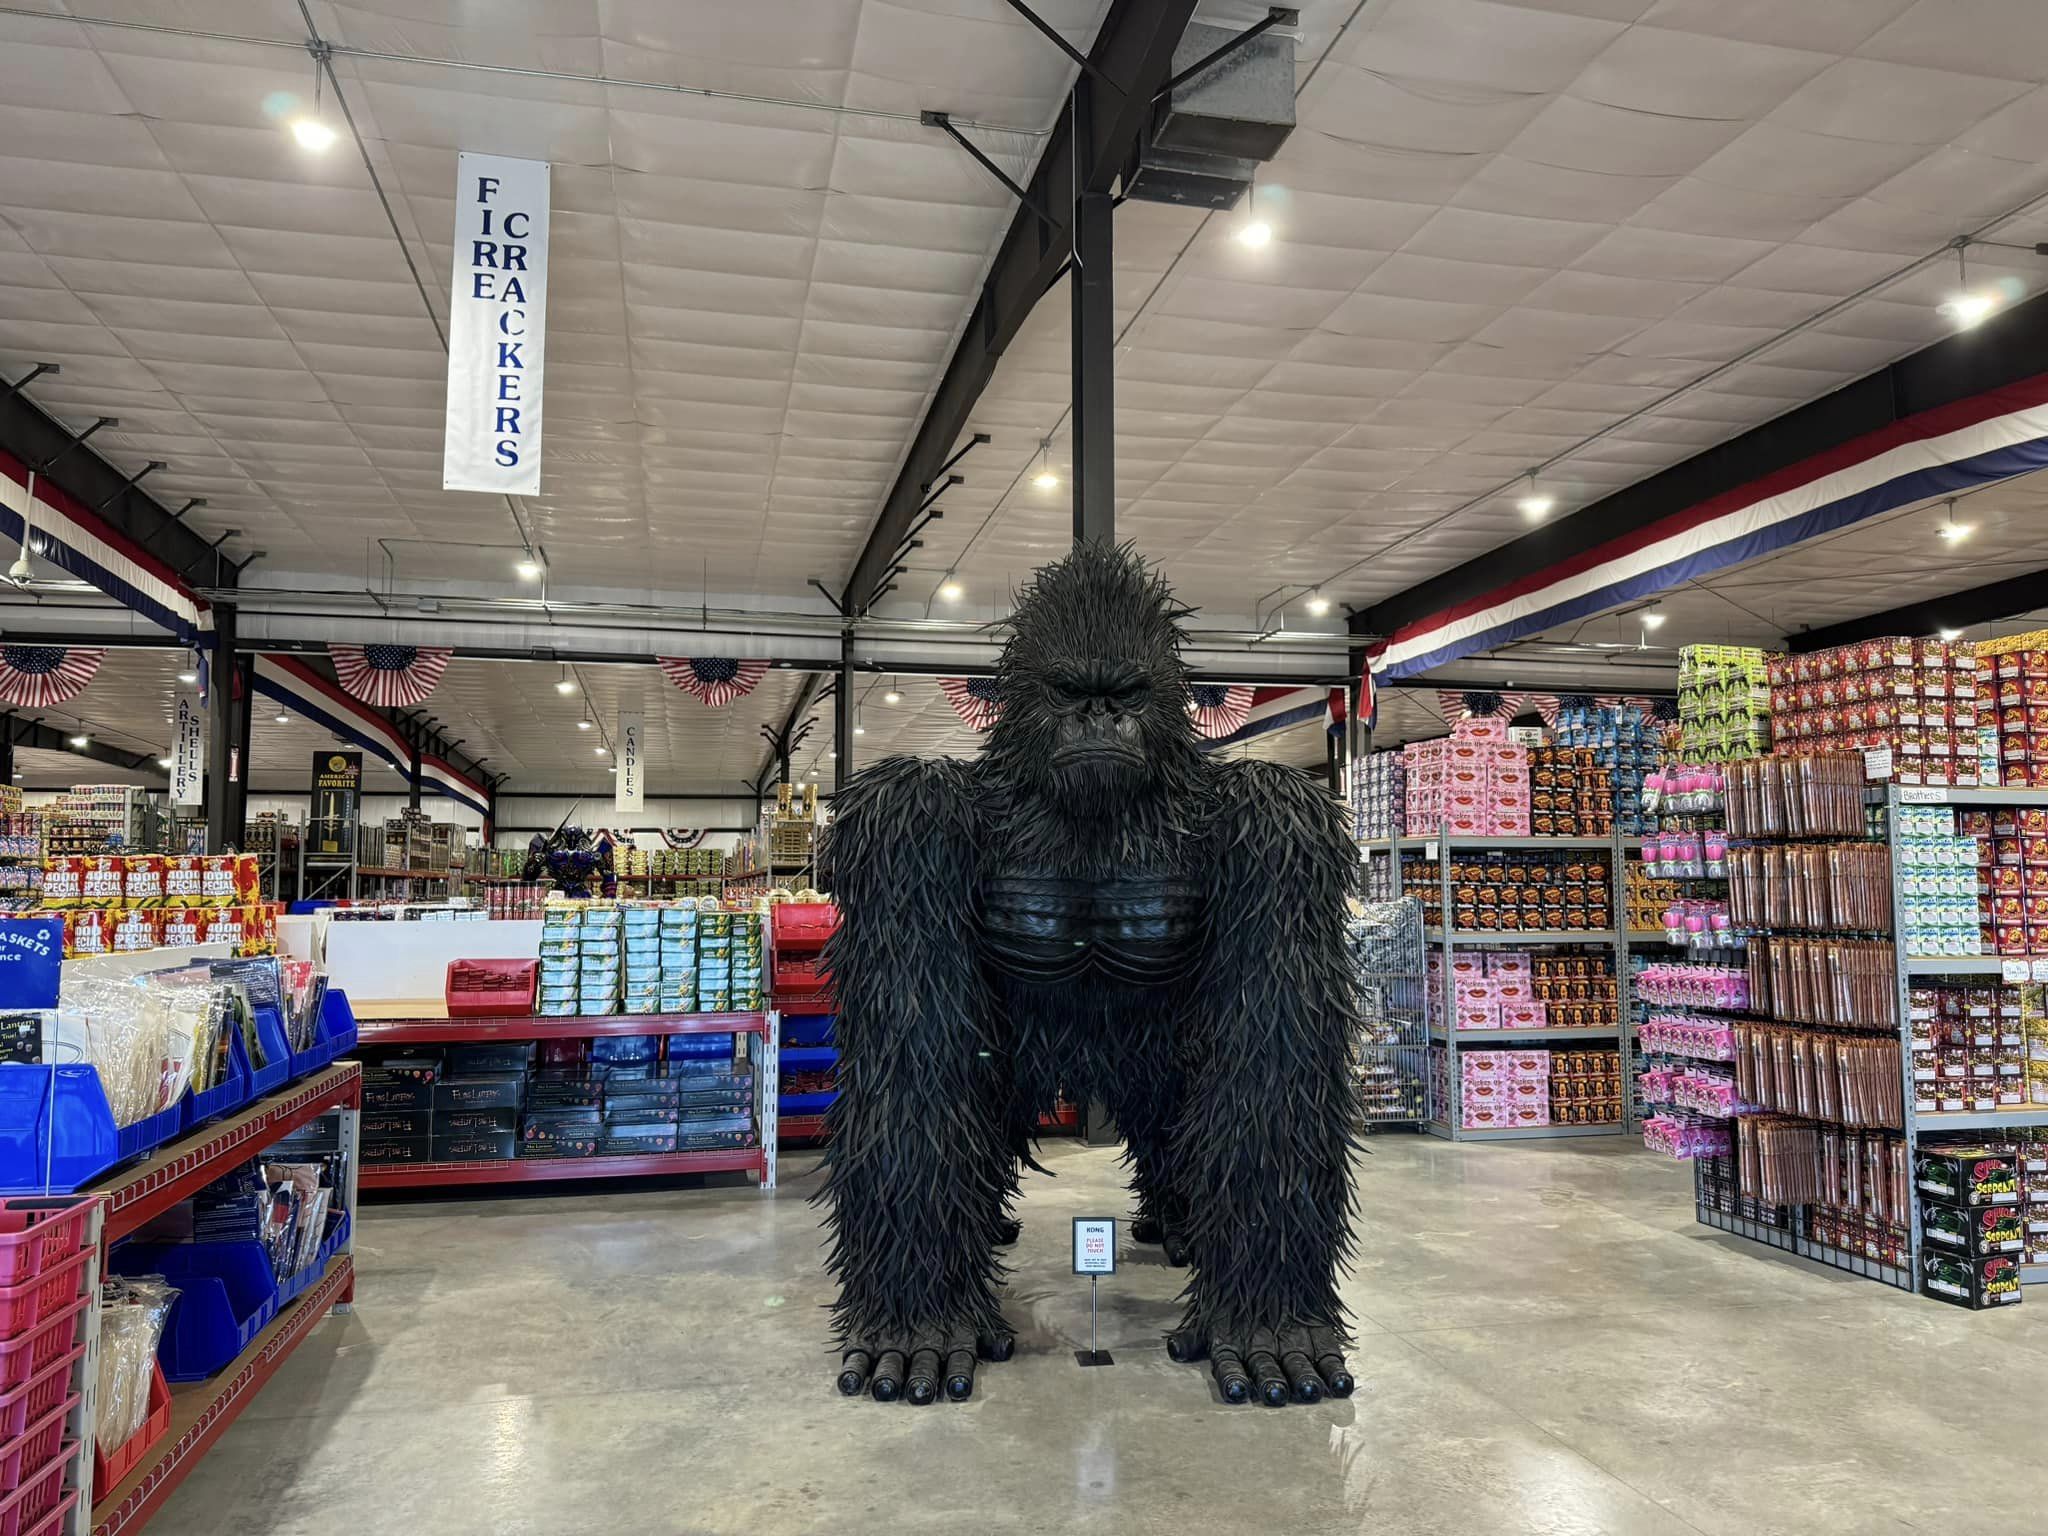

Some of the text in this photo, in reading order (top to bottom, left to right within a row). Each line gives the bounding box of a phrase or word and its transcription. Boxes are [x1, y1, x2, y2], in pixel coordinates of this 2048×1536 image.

[471, 176, 500, 300] FIRE
[494, 212, 530, 467] CRACKERS
[176, 699, 189, 798] ARTILLERY
[188, 715, 199, 782] SHELLS
[626, 726, 636, 797] CANDLES
[318, 779, 356, 788] FAVORITE
[43, 881, 81, 892] SPECIAL
[83, 880, 122, 892] SPECIAL
[125, 881, 161, 892] SPECIAL
